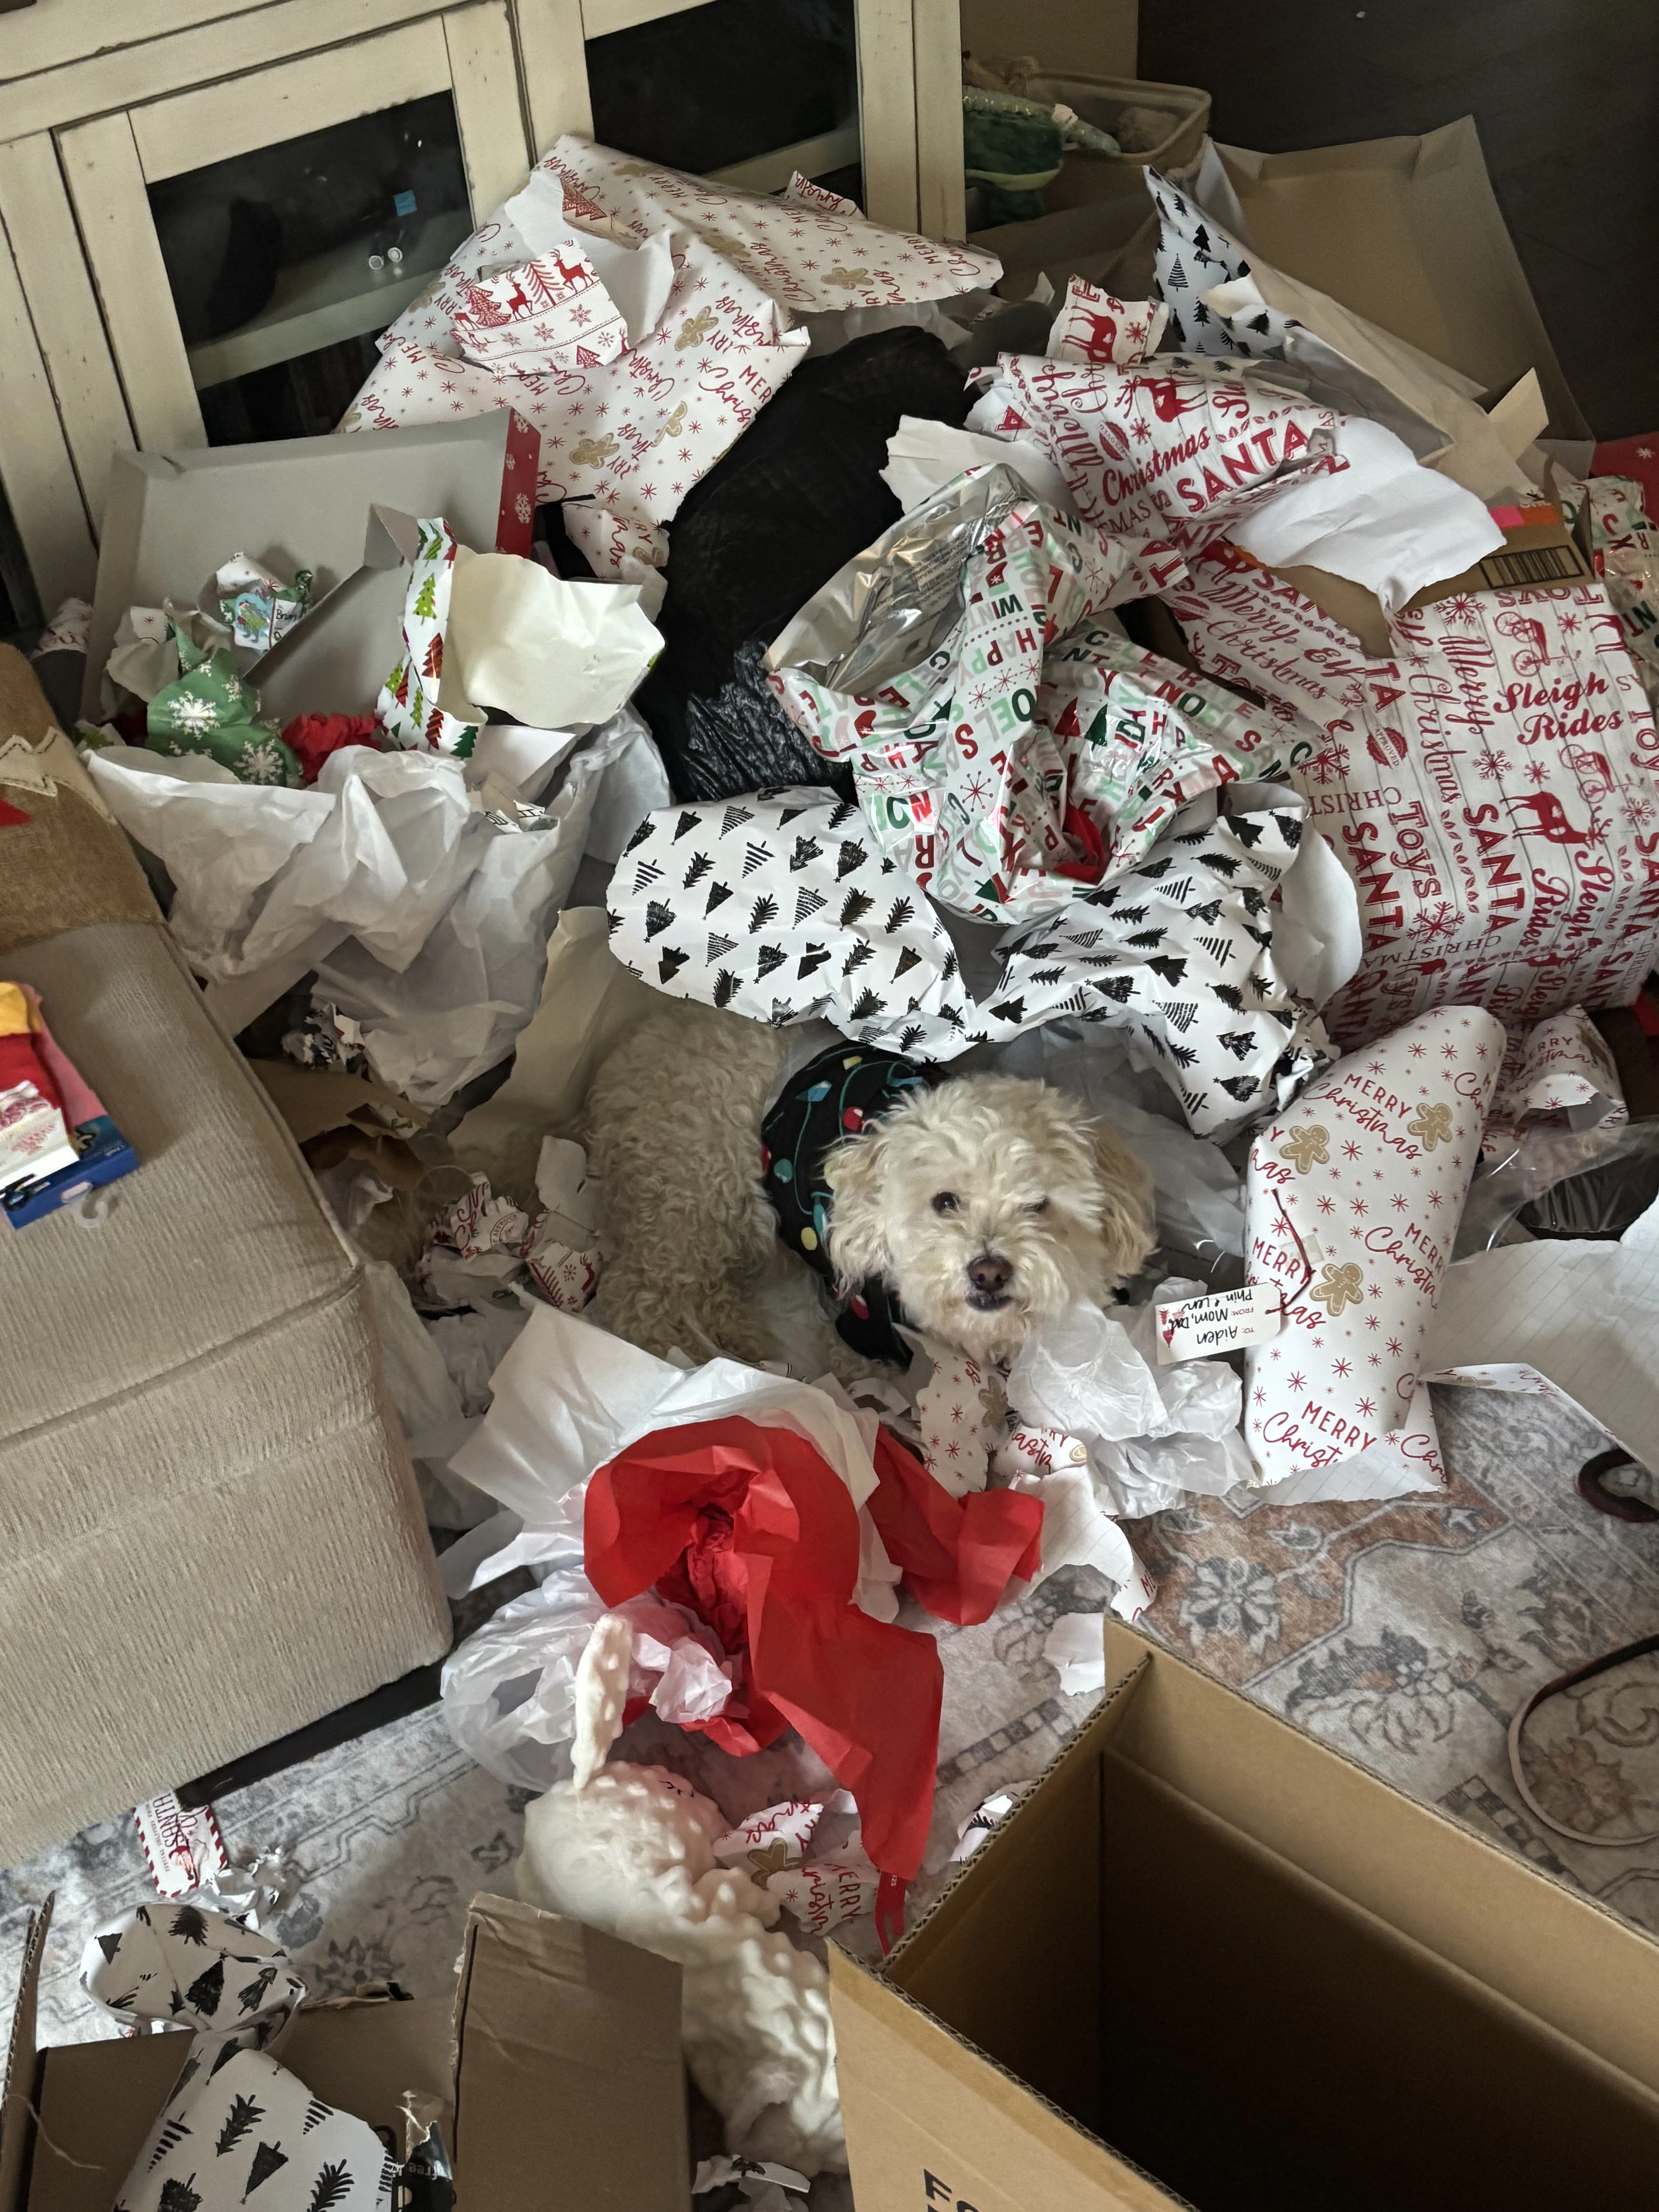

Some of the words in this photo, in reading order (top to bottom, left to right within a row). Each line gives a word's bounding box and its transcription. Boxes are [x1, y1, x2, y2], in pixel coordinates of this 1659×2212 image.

[750, 242, 816, 302] Christmas
[899, 234, 942, 264] MERRY
[626, 349, 675, 402] Christm
[739, 365, 773, 404] MER
[1103, 427, 1211, 506] Christmas
[1177, 420, 1307, 514] SANTA
[1200, 582, 1300, 644] Merry
[959, 628, 1037, 686] HAPPY
[1207, 621, 1329, 700] Christmas
[1438, 635, 1495, 735] Merry
[974, 687, 1035, 739] OEL
[1493, 672, 1608, 715] Sleigh
[1408, 674, 1467, 804] Christmas
[1518, 710, 1624, 746] Rides
[1309, 787, 1403, 817] CHRIST
[1342, 821, 1406, 953] SANTA
[1462, 803, 1526, 932] SANTA
[1562, 850, 1616, 940] Sleigh
[1519, 867, 1570, 948] Rides
[1363, 934, 1502, 969] CHRISTMA
[1303, 1082, 1423, 1160] Christmas
[1344, 1073, 1412, 1119] MERRY
[1365, 1226, 1438, 1309] Christm
[1404, 1222, 1443, 1275] MERR
[1197, 1326, 1238, 1346] Aiden
[1231, 1307, 1254, 1316] FROM:
[1263, 1412, 1344, 1468] Christ
[1302, 1401, 1377, 1452] MERRY
